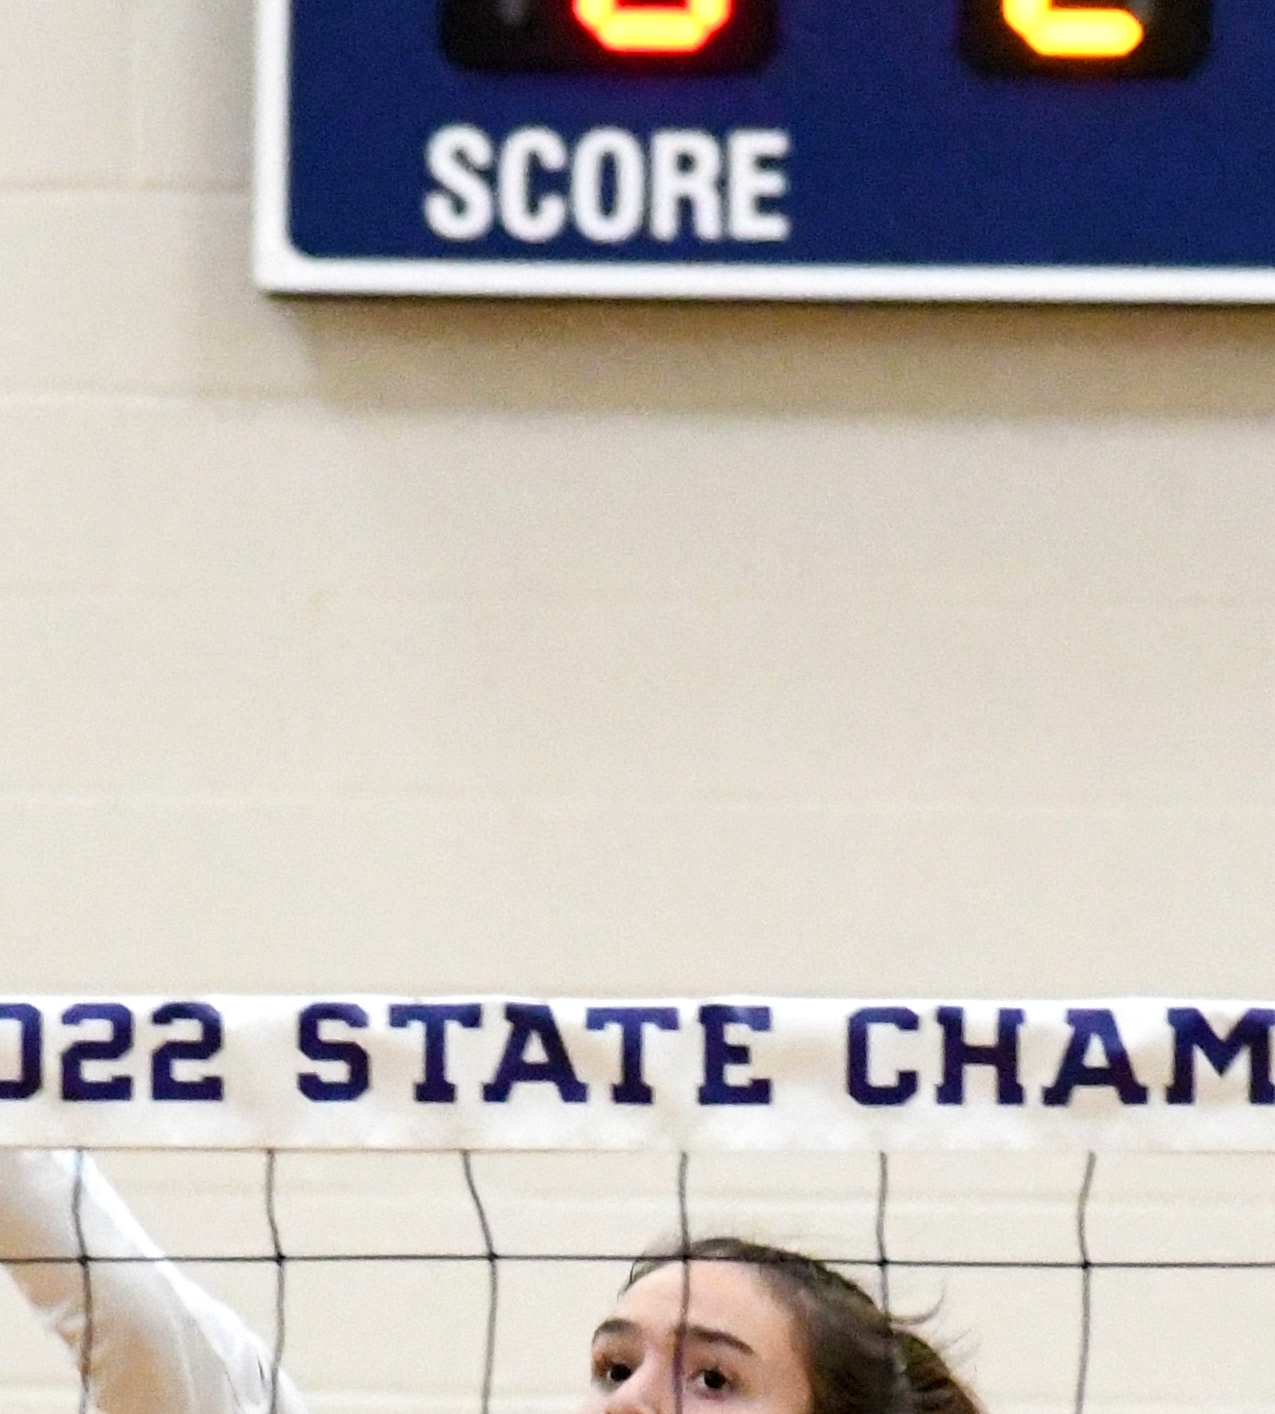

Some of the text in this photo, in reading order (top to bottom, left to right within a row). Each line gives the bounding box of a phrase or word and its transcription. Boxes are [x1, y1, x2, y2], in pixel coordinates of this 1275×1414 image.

[424, 124, 791, 243] SCORE
[298, 1003, 772, 1106] STATE
[846, 1007, 1275, 1107] CHAM
